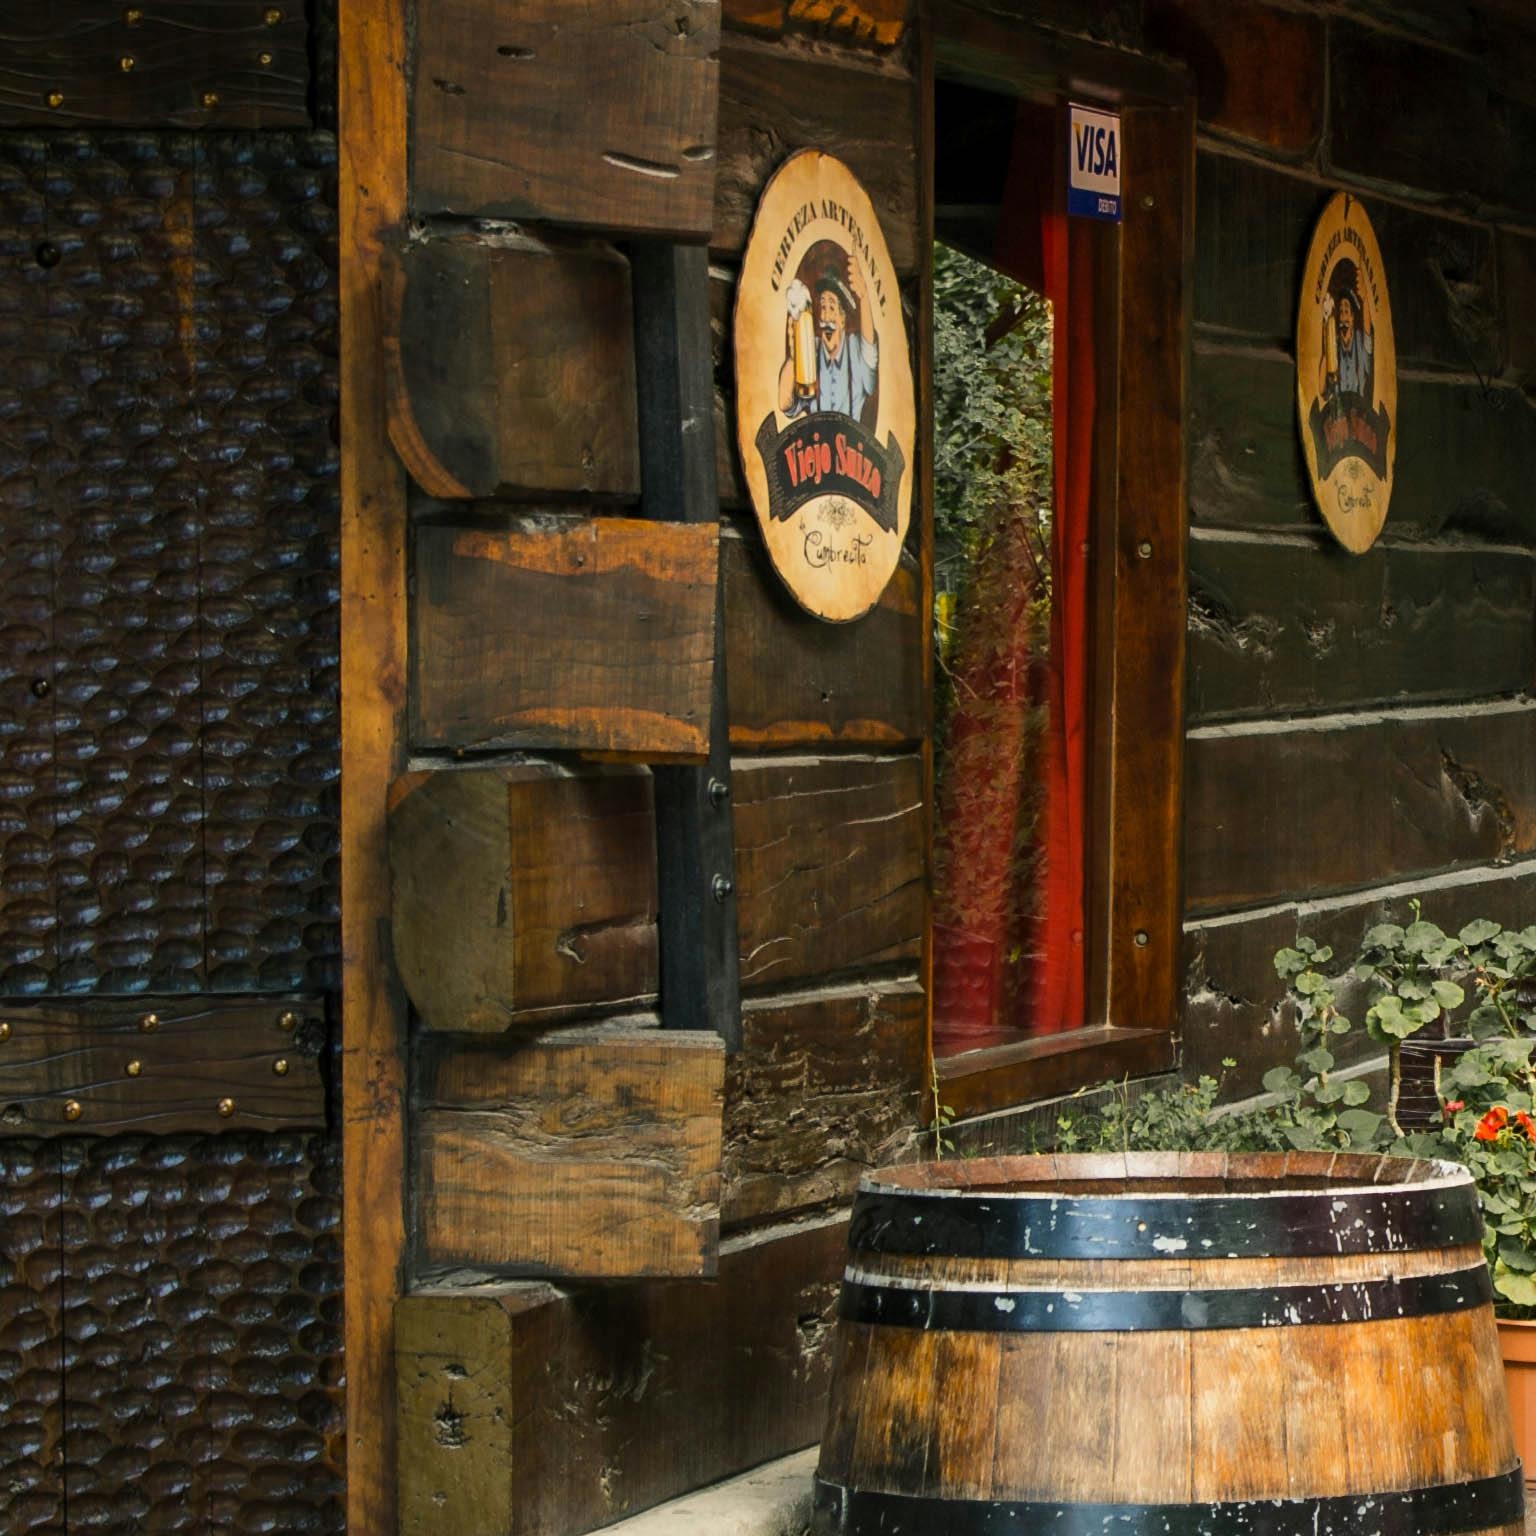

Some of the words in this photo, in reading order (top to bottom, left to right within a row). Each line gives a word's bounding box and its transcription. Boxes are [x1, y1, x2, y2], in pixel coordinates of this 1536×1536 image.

[1072, 123, 1117, 178] VISA
[771, 202, 817, 292] CERVEZA
[821, 199, 886, 317] ARTESANAL
[784, 432, 831, 487] Viejo
[835, 433, 881, 498] Suizo
